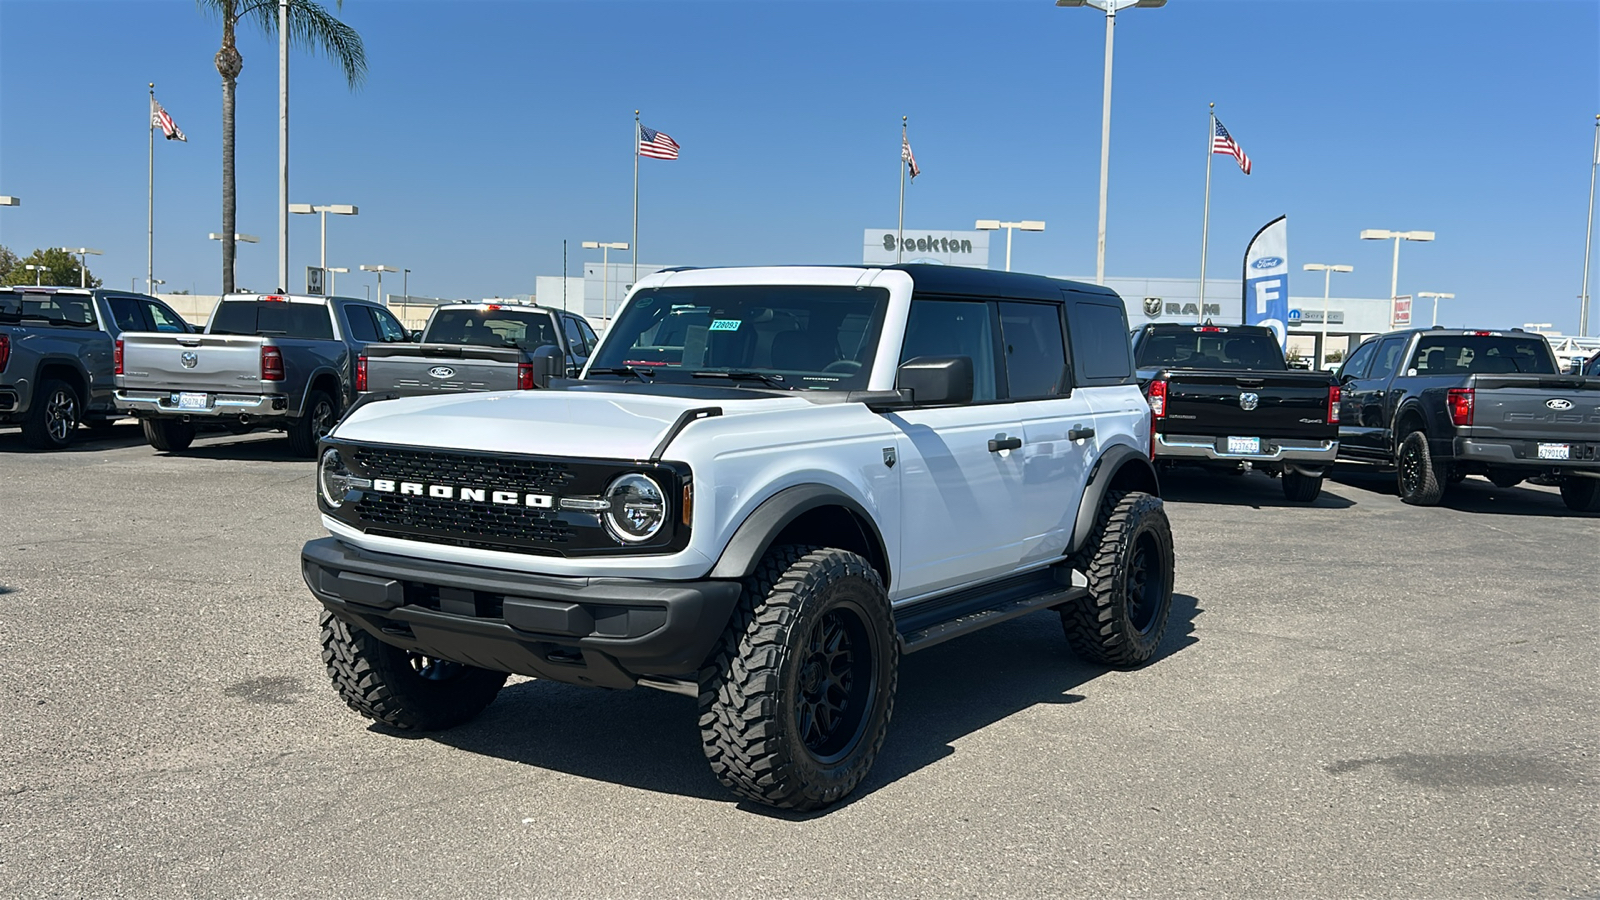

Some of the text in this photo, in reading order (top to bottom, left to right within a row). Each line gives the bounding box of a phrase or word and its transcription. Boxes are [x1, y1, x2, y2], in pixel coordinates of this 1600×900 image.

[883, 234, 972, 253] Stockton
[1165, 302, 1220, 315] RAM
[712, 321, 739, 329] T28093
[373, 478, 553, 508] BRONCO
